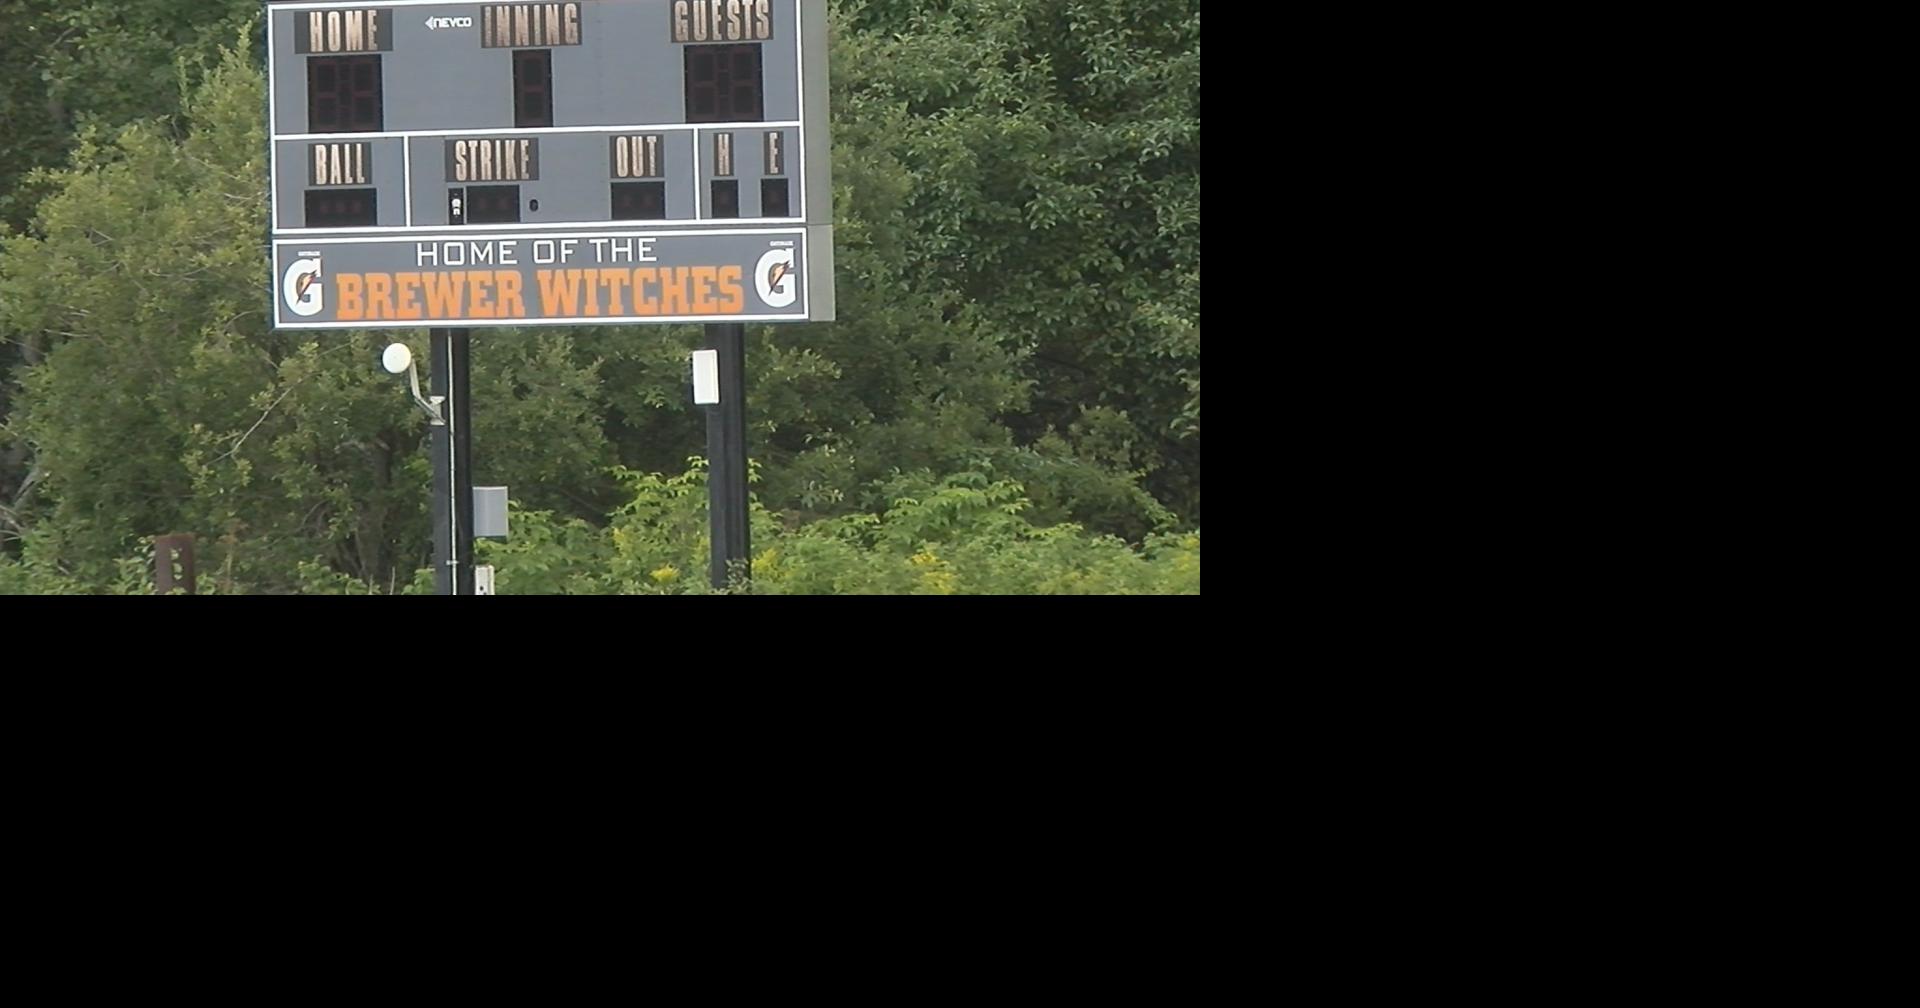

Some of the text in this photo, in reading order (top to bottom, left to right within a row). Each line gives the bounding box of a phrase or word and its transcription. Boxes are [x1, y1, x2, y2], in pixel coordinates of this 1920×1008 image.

[309, 10, 377, 52] HOME
[484, 3, 578, 47] INNING
[674, 0, 769, 41] GUESTS
[315, 143, 365, 184] BALL
[455, 139, 529, 181] STRIKE
[616, 135, 657, 177] OUT
[718, 133, 730, 175] H
[769, 132, 779, 174] E
[417, 237, 657, 266] HOME OF THE
[336, 264, 744, 321] BREWER WITCHES
